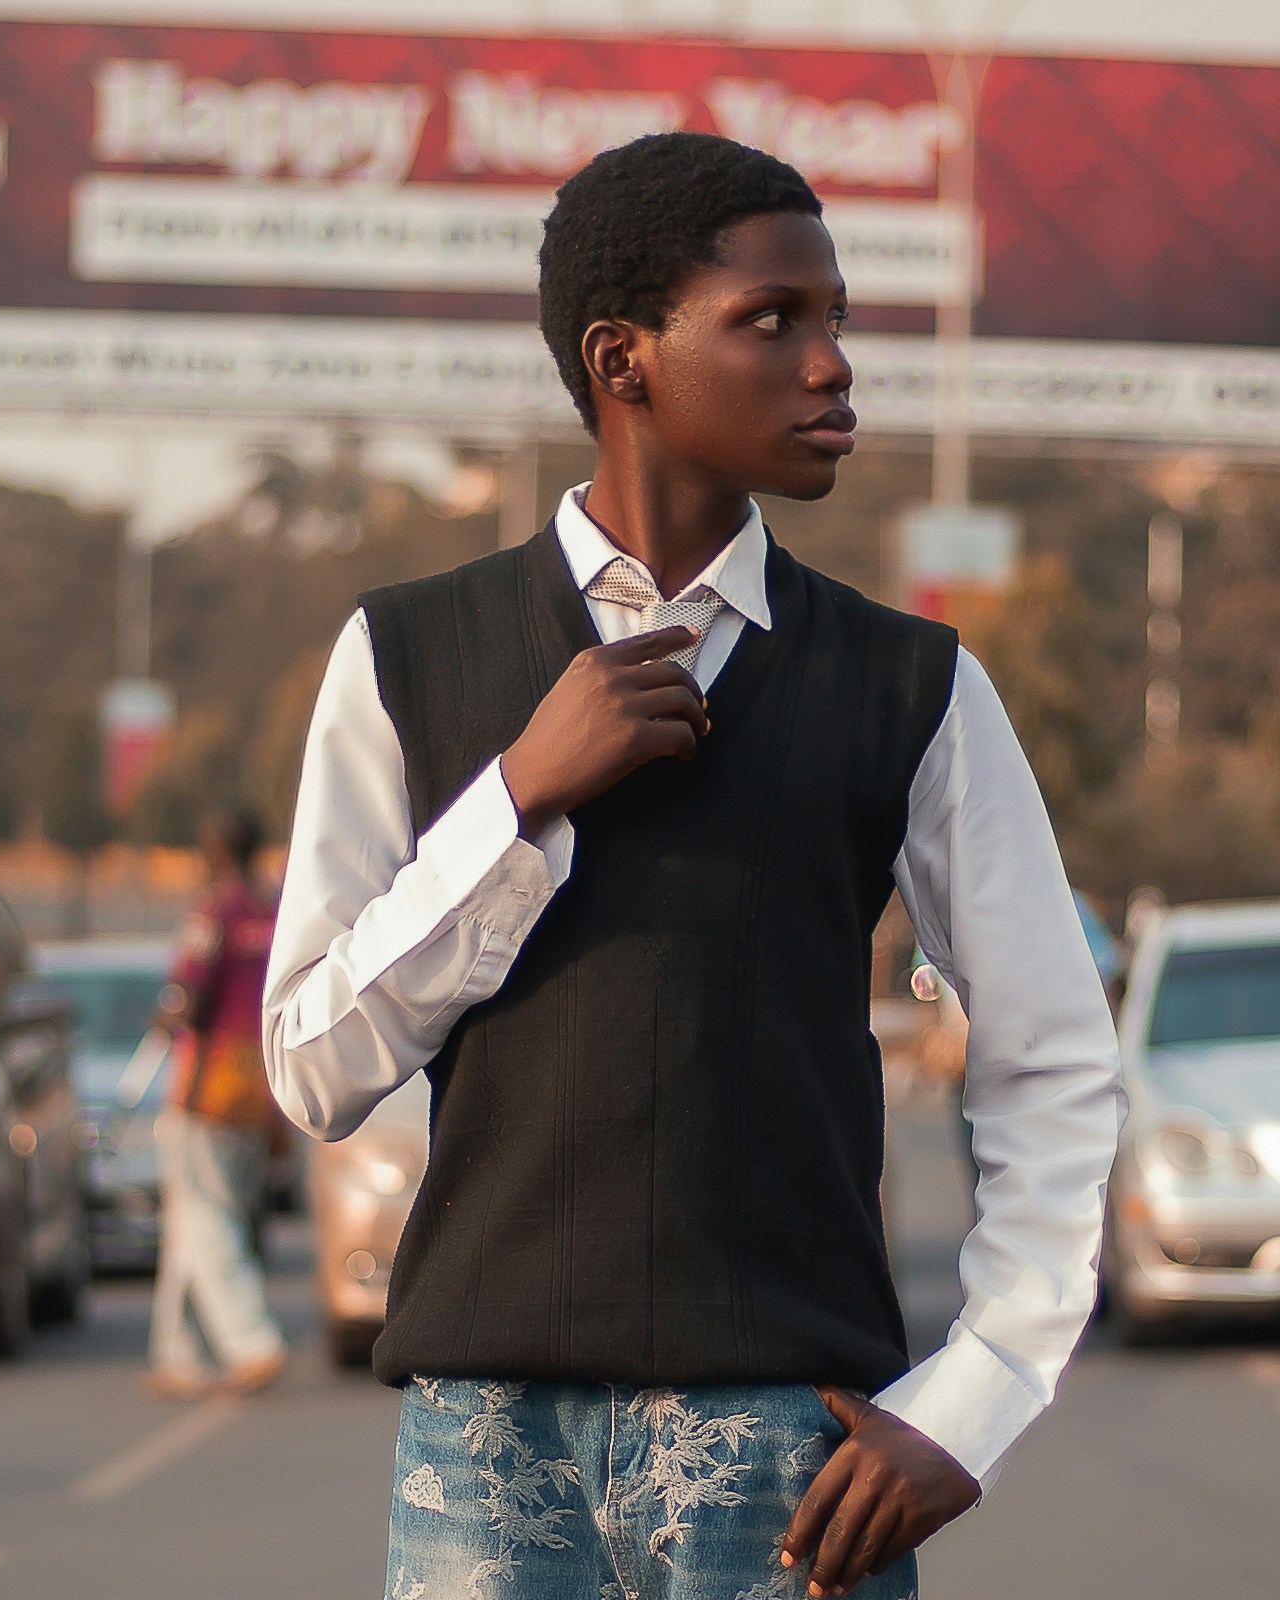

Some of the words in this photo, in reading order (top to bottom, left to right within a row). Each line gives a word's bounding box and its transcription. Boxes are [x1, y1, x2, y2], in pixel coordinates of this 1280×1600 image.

[91, 58, 430, 196] Happy
[446, 70, 686, 176] New
[705, 78, 962, 188] Year
